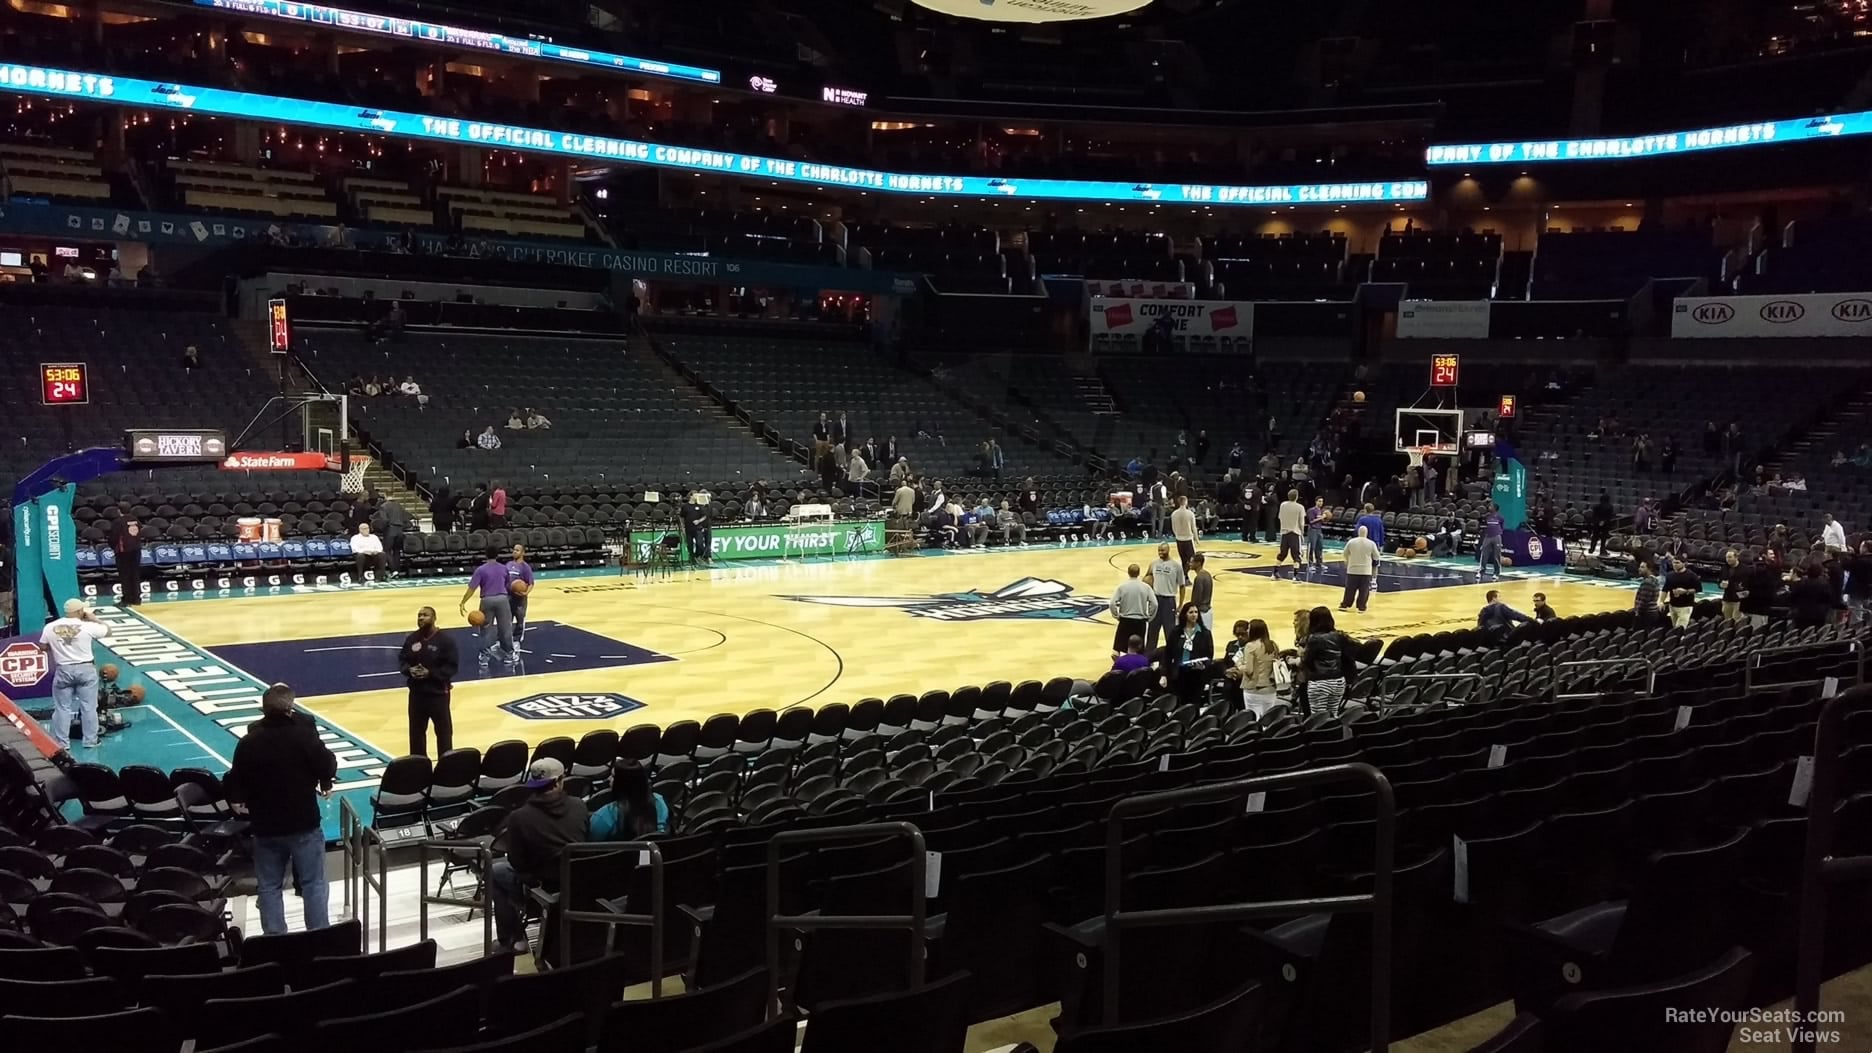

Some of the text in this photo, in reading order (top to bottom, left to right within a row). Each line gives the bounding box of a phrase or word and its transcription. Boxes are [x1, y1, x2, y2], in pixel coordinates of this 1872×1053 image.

[840, 95, 865, 107] HEALTH
[1488, 143, 1515, 162] OF
[1523, 141, 1560, 161] THE
[1565, 133, 1678, 159] CHARLOTTE
[1685, 122, 1776, 148] HORNETS
[422, 116, 461, 137] THE
[468, 121, 555, 149] OFFICIAL
[561, 134, 649, 160] CLEANING
[655, 146, 735, 169] COMPANY
[740, 156, 761, 172] OF
[766, 159, 796, 176] THE
[801, 164, 884, 187] CHARLOTTE
[888, 174, 964, 192] HORNETS
[1181, 185, 1212, 200] THE
[1218, 185, 1292, 201] OFFICIAL
[1299, 184, 1384, 201] CLEANING
[602, 254, 657, 272] CASINO
[664, 258, 718, 277] RESORT
[1700, 307, 1728, 320] KIA
[1767, 305, 1797, 319] KIA
[1840, 304, 1871, 317] KIA
[1152, 318, 1189, 331] ZNE
[1435, 357, 1457, 368] 53:06
[46, 368, 81, 382] 53:06
[1436, 367, 1455, 382] 24
[53, 382, 76, 398] 24
[158, 435, 202, 446] HICKORY
[158, 444, 202, 456] TAVERN
[711, 531, 837, 553] EY YOUR THIRST
[243, 576, 256, 587] G
[268, 575, 281, 586] G
[293, 573, 305, 584] G
[364, 570, 375, 580] G
[166, 580, 179, 591] G
[192, 579, 205, 590] G
[218, 577, 230, 588] G
[84, 584, 98, 596] G
[2, 656, 45, 672] CPI
[516, 695, 615, 711] BUZZ
[537, 702, 624, 717] CITY
[398, 828, 411, 838] 18
